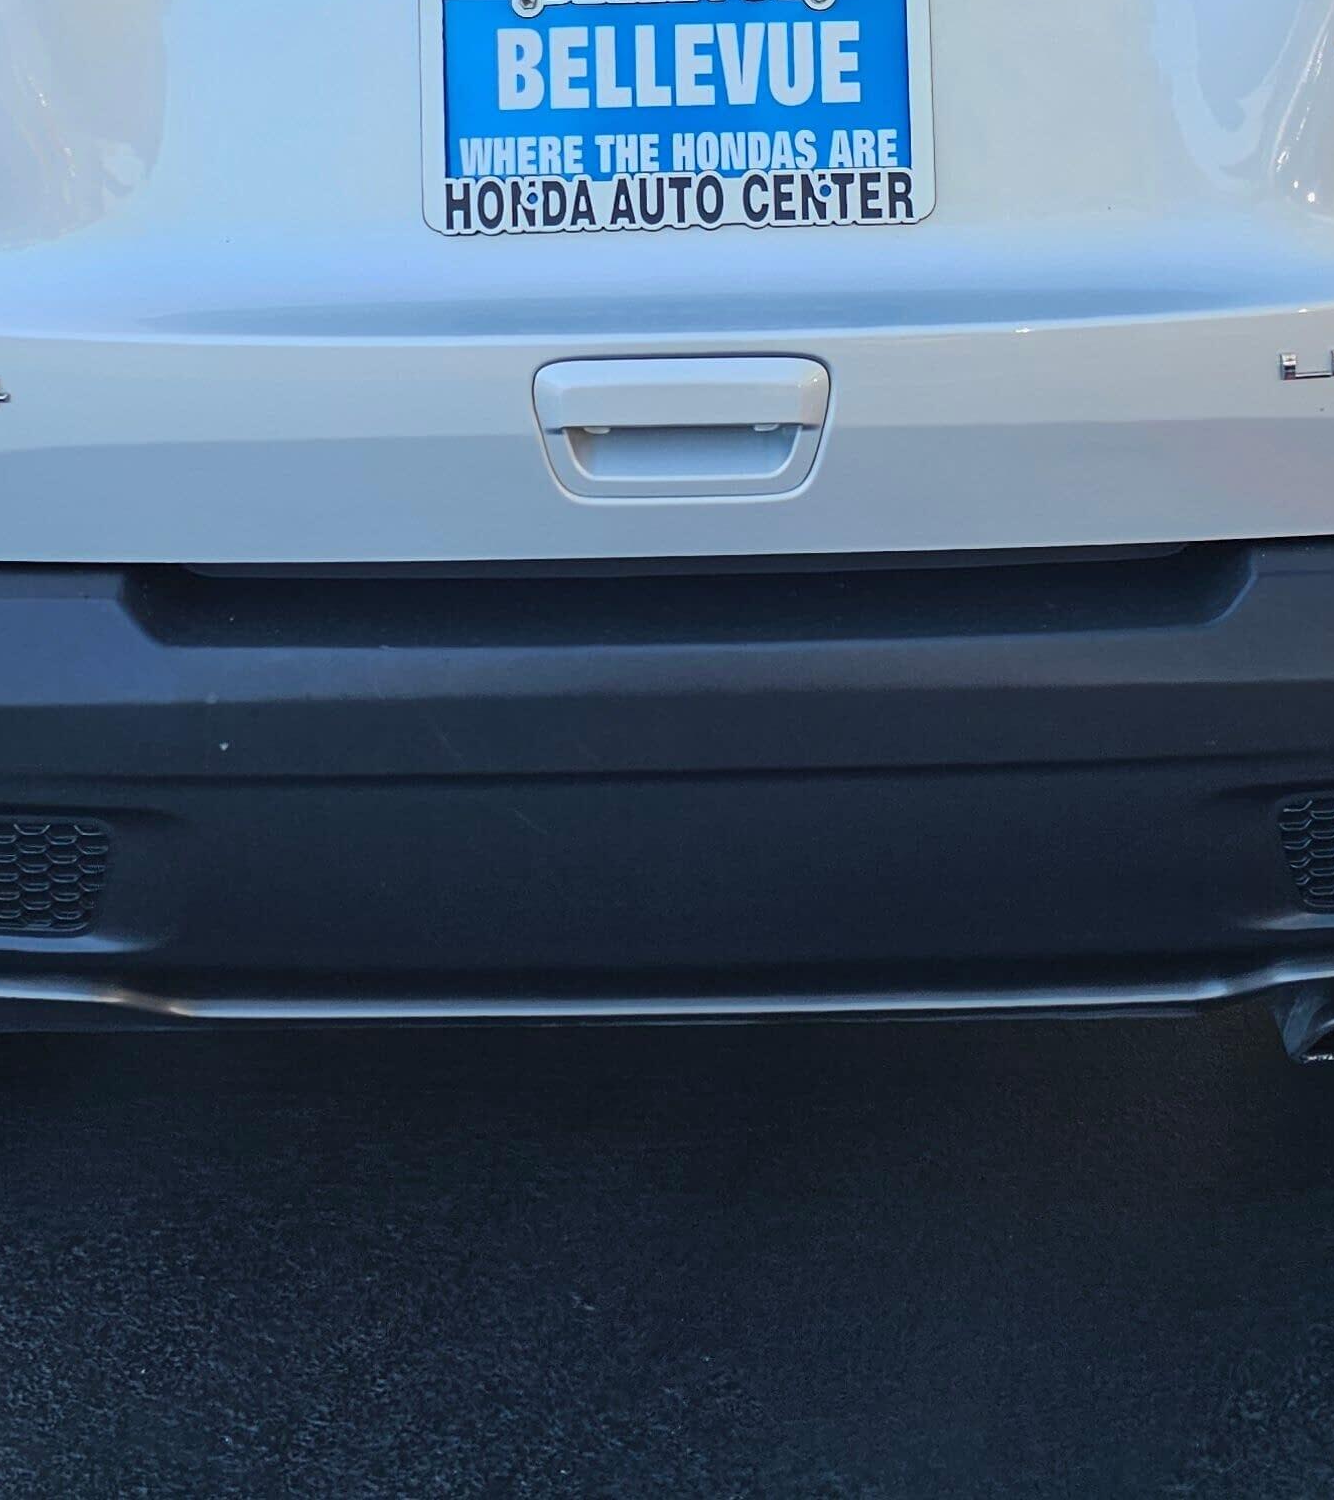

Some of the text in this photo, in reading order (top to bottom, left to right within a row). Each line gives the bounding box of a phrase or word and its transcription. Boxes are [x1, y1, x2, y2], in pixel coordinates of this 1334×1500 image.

[497, 21, 861, 111] BELLEVUE
[459, 128, 898, 176] WHERE THE HONDAS ARE
[444, 171, 914, 230] HONDA AUTO CENTER
